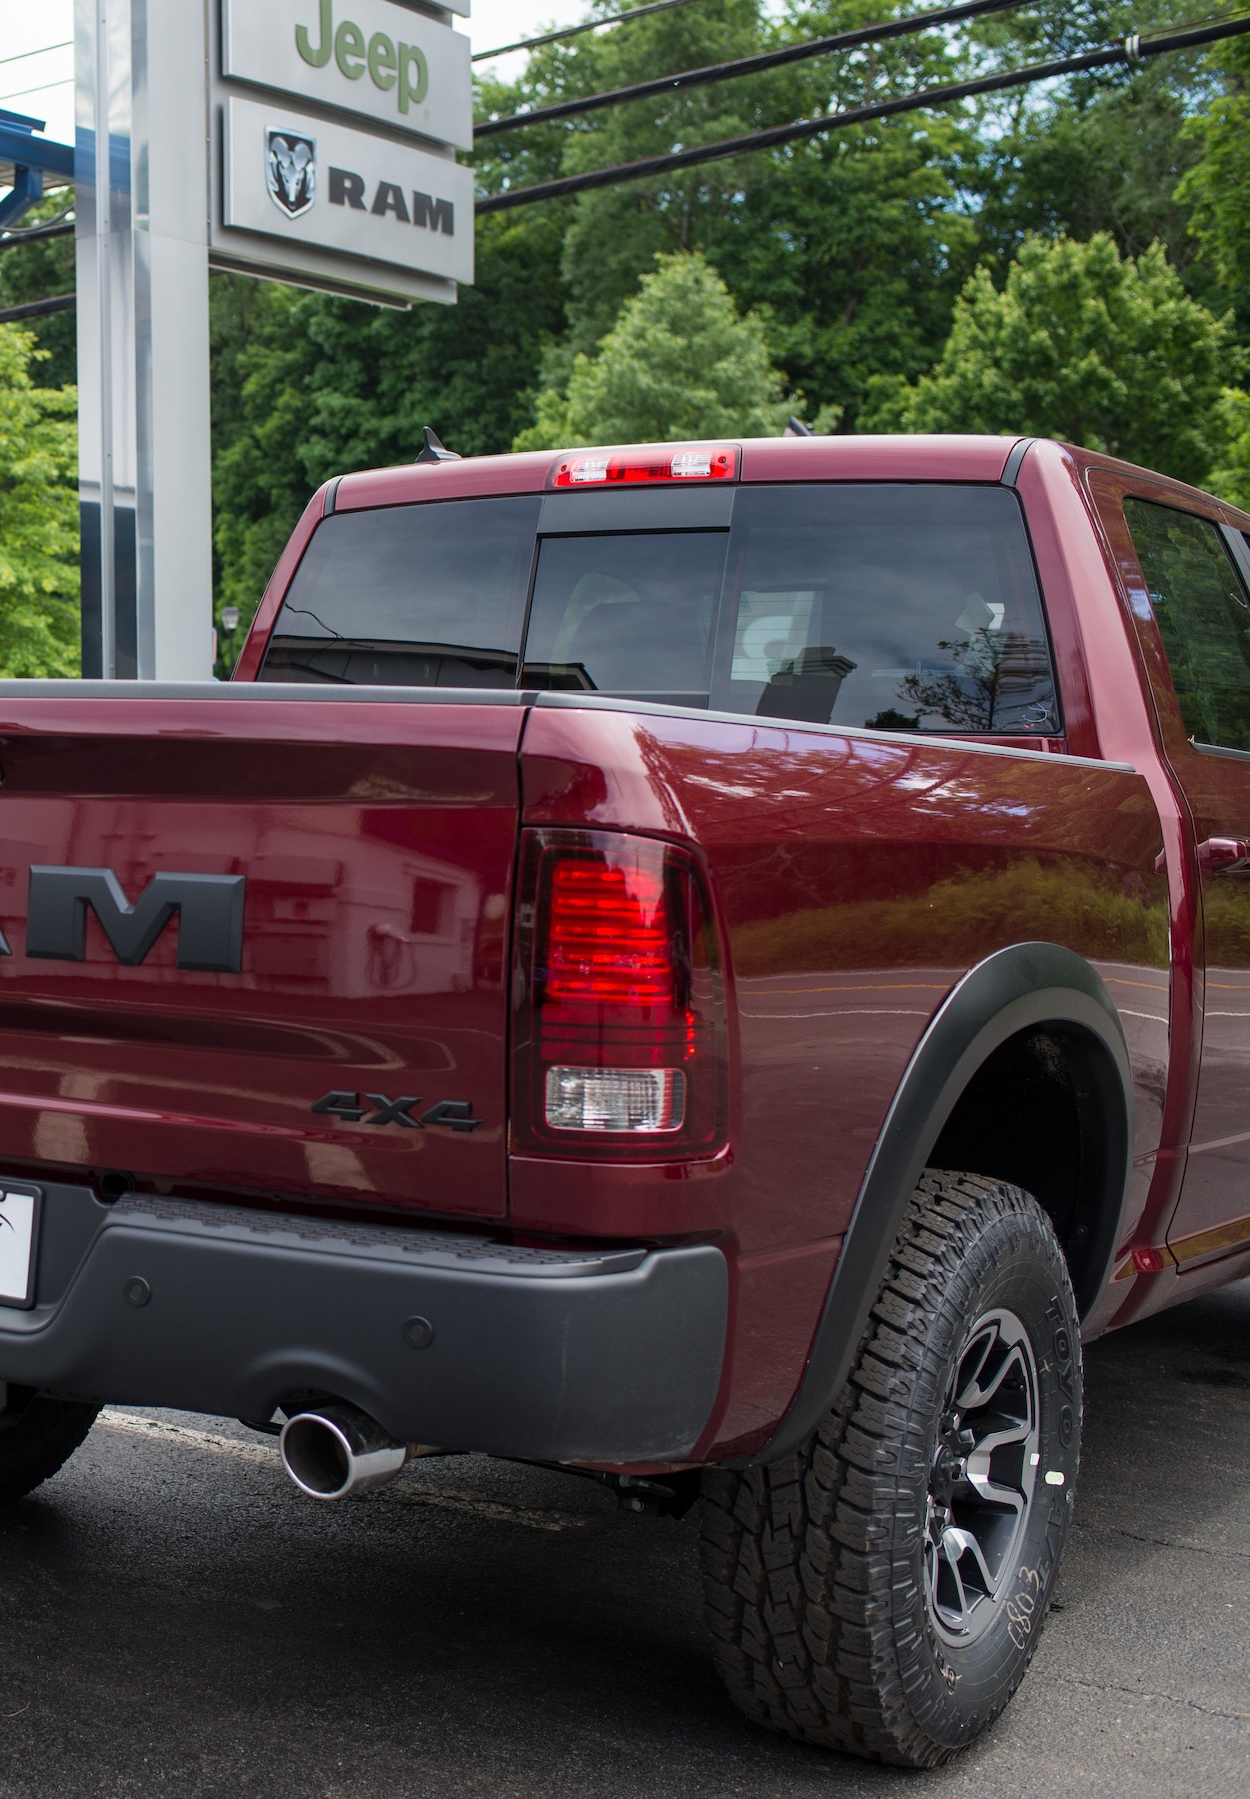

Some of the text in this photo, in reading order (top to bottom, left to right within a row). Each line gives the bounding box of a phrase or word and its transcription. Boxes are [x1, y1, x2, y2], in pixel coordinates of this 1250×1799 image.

[295, 0, 429, 115] Jeep
[328, 166, 455, 236] RAM
[1045, 1295, 1075, 1450] TOYO
